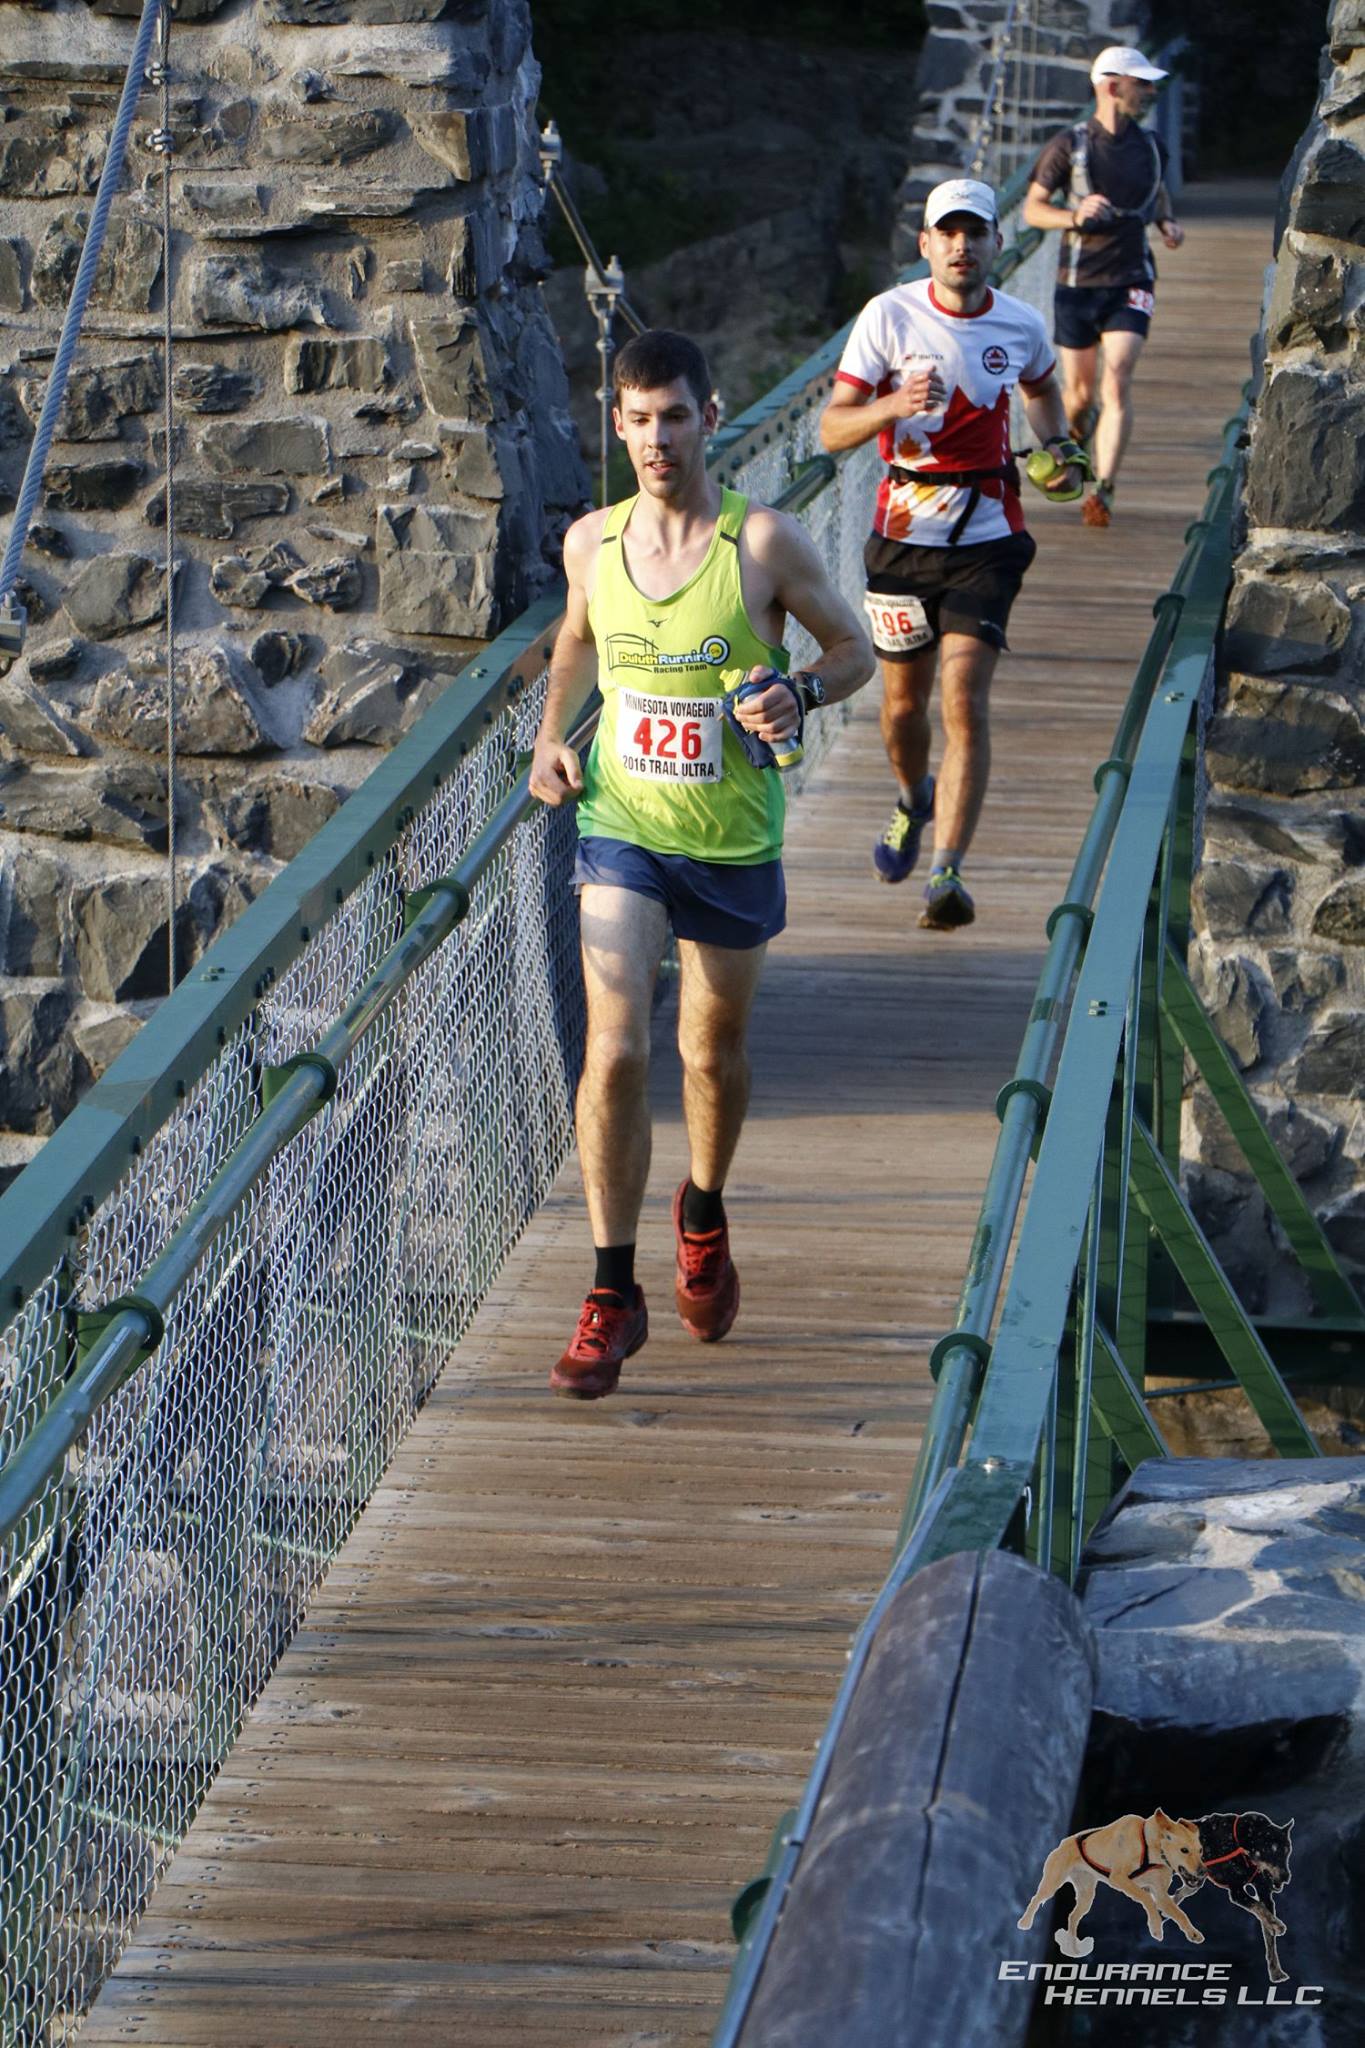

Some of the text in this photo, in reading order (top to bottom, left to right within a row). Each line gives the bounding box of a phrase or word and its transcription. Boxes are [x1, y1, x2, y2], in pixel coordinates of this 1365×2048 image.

[653, 665, 684, 673] Racing
[625, 693, 715, 718] MINNESOTA VOYAGEUR
[633, 717, 702, 760] 426
[623, 755, 715, 777] 2016 TRAIL ULTRA
